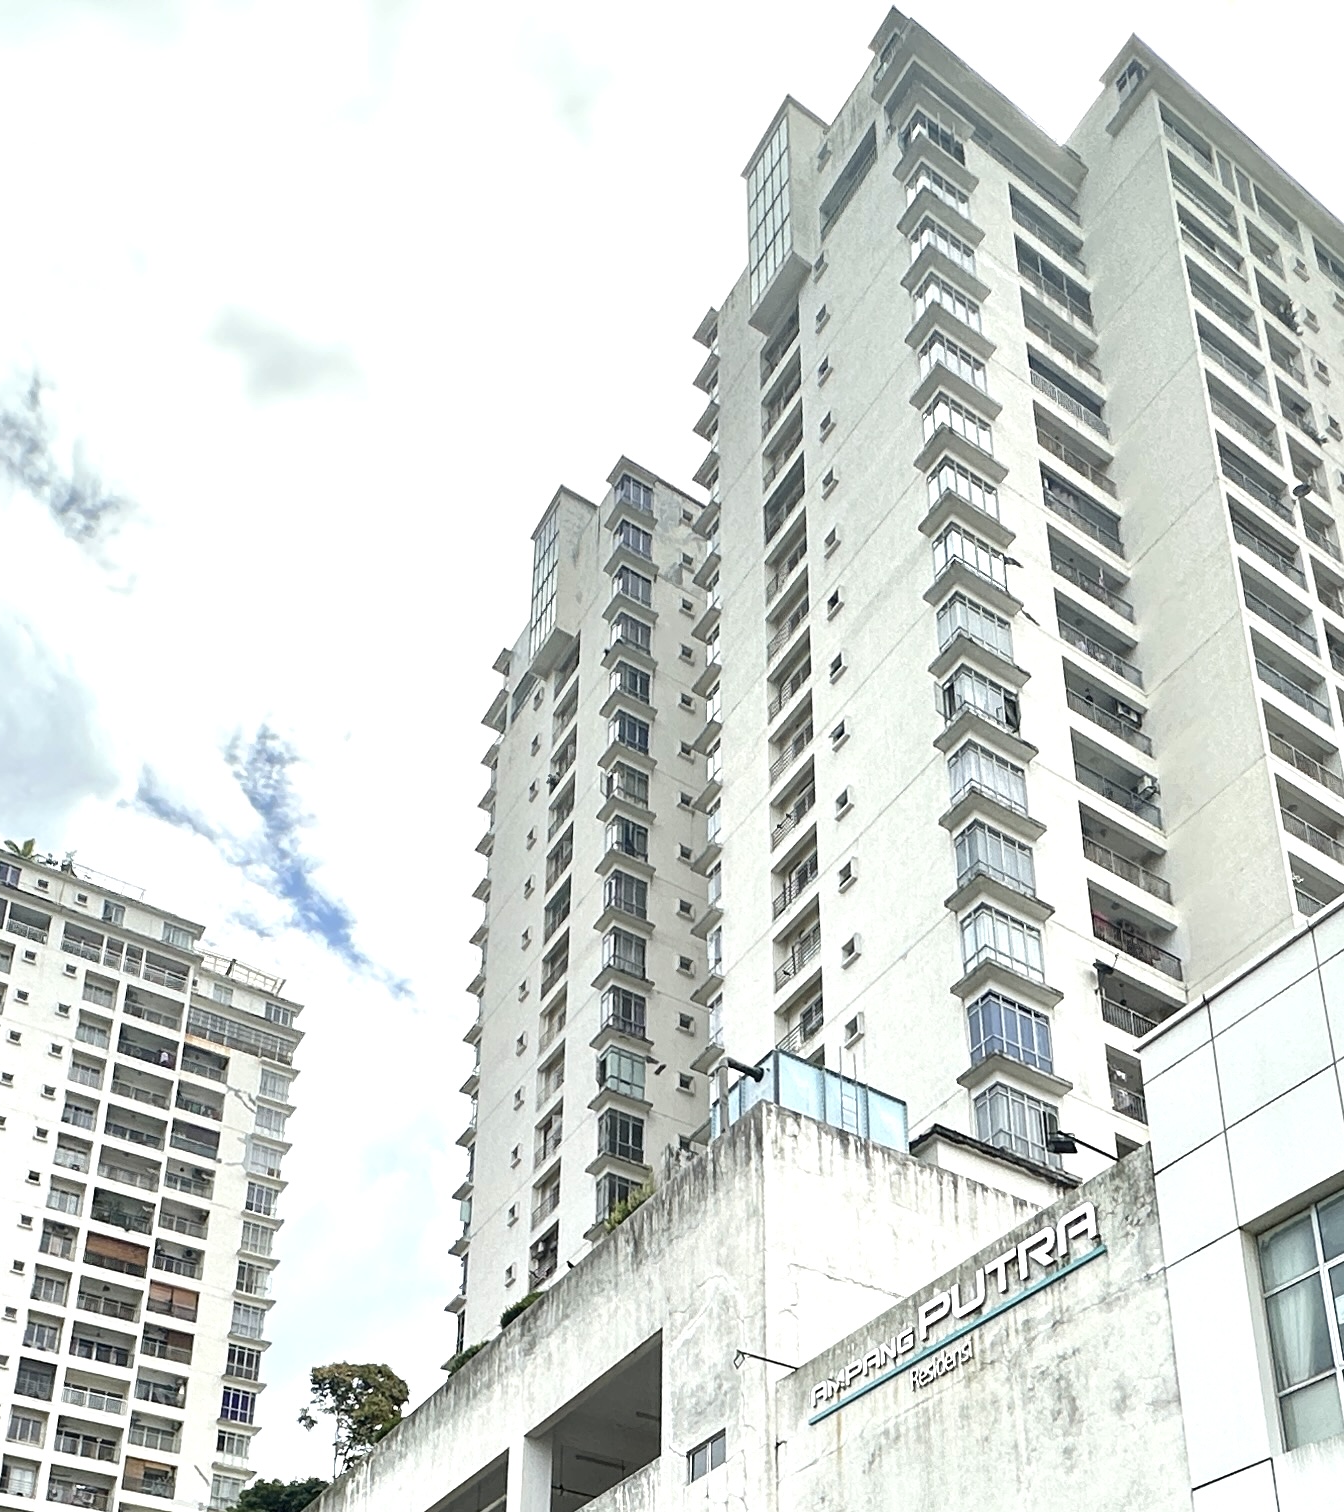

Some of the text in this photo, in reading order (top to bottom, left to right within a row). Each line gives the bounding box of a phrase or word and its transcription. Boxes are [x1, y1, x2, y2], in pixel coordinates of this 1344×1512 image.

[809, 1201, 1099, 1408] AMPANG PUTRA
[910, 1336, 974, 1392] Residensi
